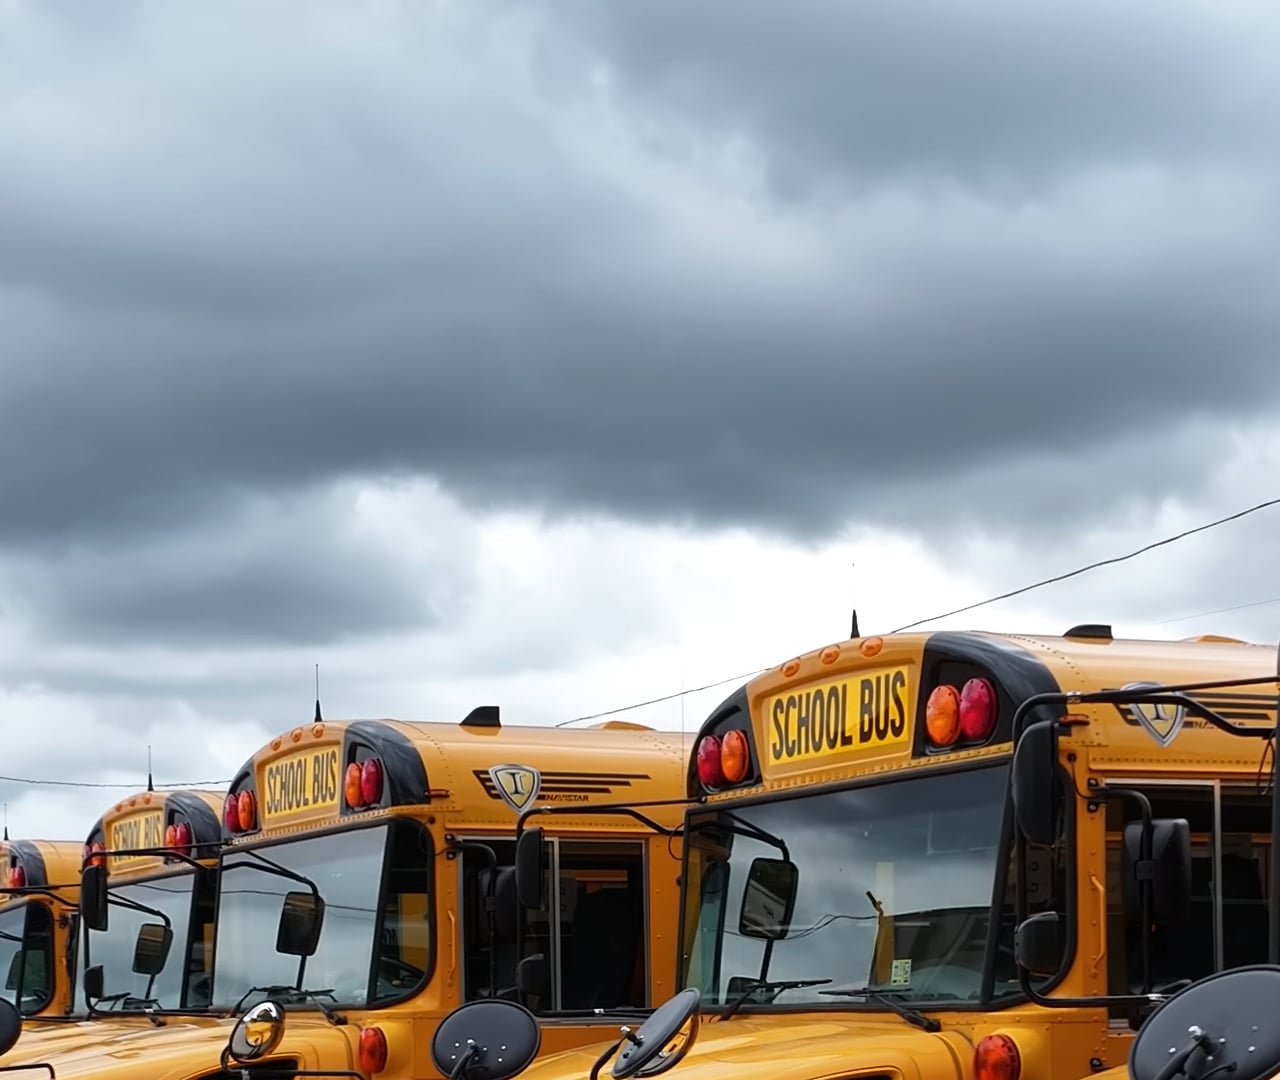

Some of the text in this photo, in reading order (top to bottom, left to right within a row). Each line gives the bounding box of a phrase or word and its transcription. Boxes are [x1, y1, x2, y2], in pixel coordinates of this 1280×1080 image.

[772, 670, 906, 760] SCHOOL BUS
[267, 750, 337, 815] SCHOOL BUS
[112, 814, 161, 863] SCHOOL BUS
